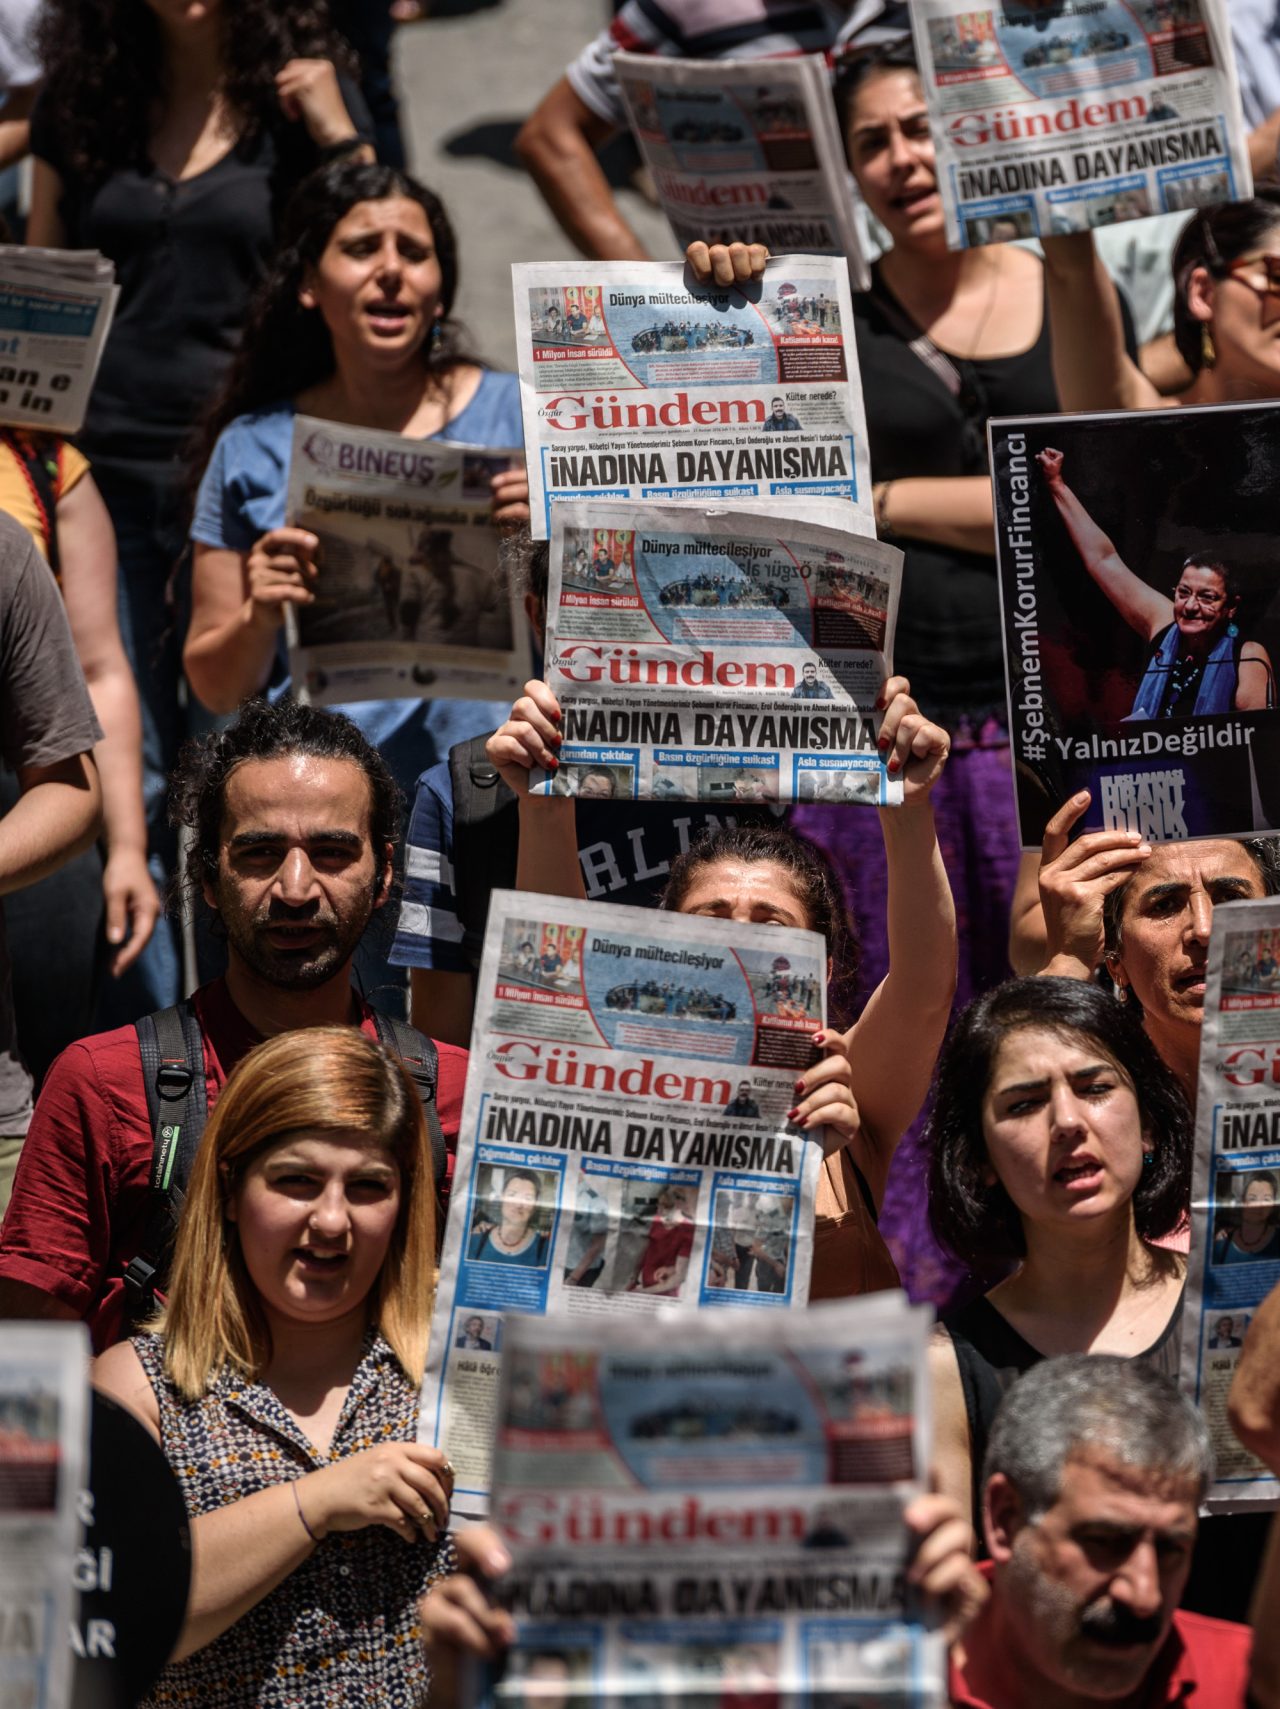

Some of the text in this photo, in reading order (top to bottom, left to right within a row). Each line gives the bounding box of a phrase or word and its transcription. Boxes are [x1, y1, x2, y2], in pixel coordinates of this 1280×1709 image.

[609, 292, 647, 307] Dünya
[544, 393, 766, 430] Gündem
[677, 446, 847, 482] DAYANIŞMA
[642, 539, 773, 561] Dünya mültecileşiyor
[559, 646, 795, 688] Gündem
[694, 714, 878, 751] DAYANIŞMA
[1054, 722, 1256, 761] YalnızDeğildir
[560, 749, 598, 762] ğırından
[658, 752, 684, 764] Basın
[798, 756, 818, 768] Asla
[592, 938, 724, 970] Dünya mültecileşiyor
[494, 1041, 732, 1105] Gündem
[624, 1127, 795, 1174] DAYANIŞMA
